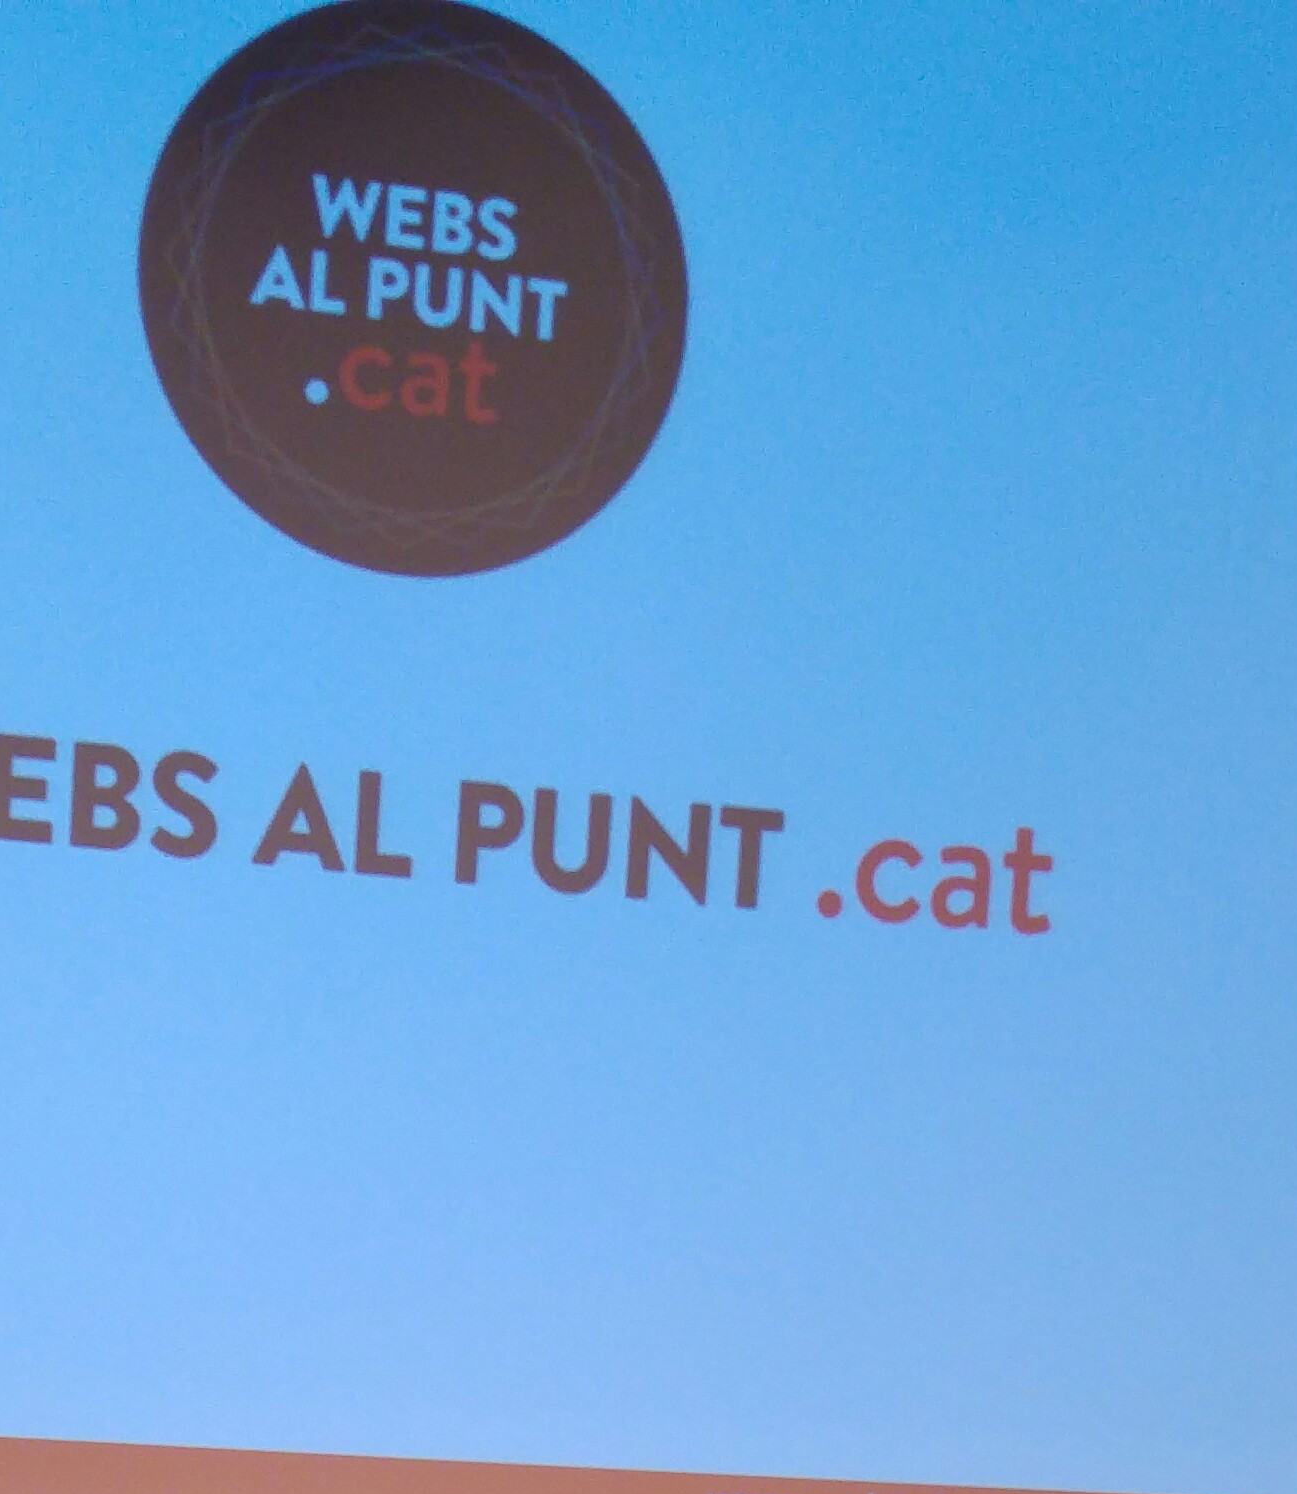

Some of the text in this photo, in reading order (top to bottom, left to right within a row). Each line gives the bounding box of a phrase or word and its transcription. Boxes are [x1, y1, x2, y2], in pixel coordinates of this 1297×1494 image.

[312, 174, 517, 261] WEBS
[249, 245, 568, 340] AL PUNT
[305, 341, 498, 423] .cat
[252, 762, 411, 877] AL
[453, 779, 784, 909] PUNT
[817, 827, 1053, 935] .cat
